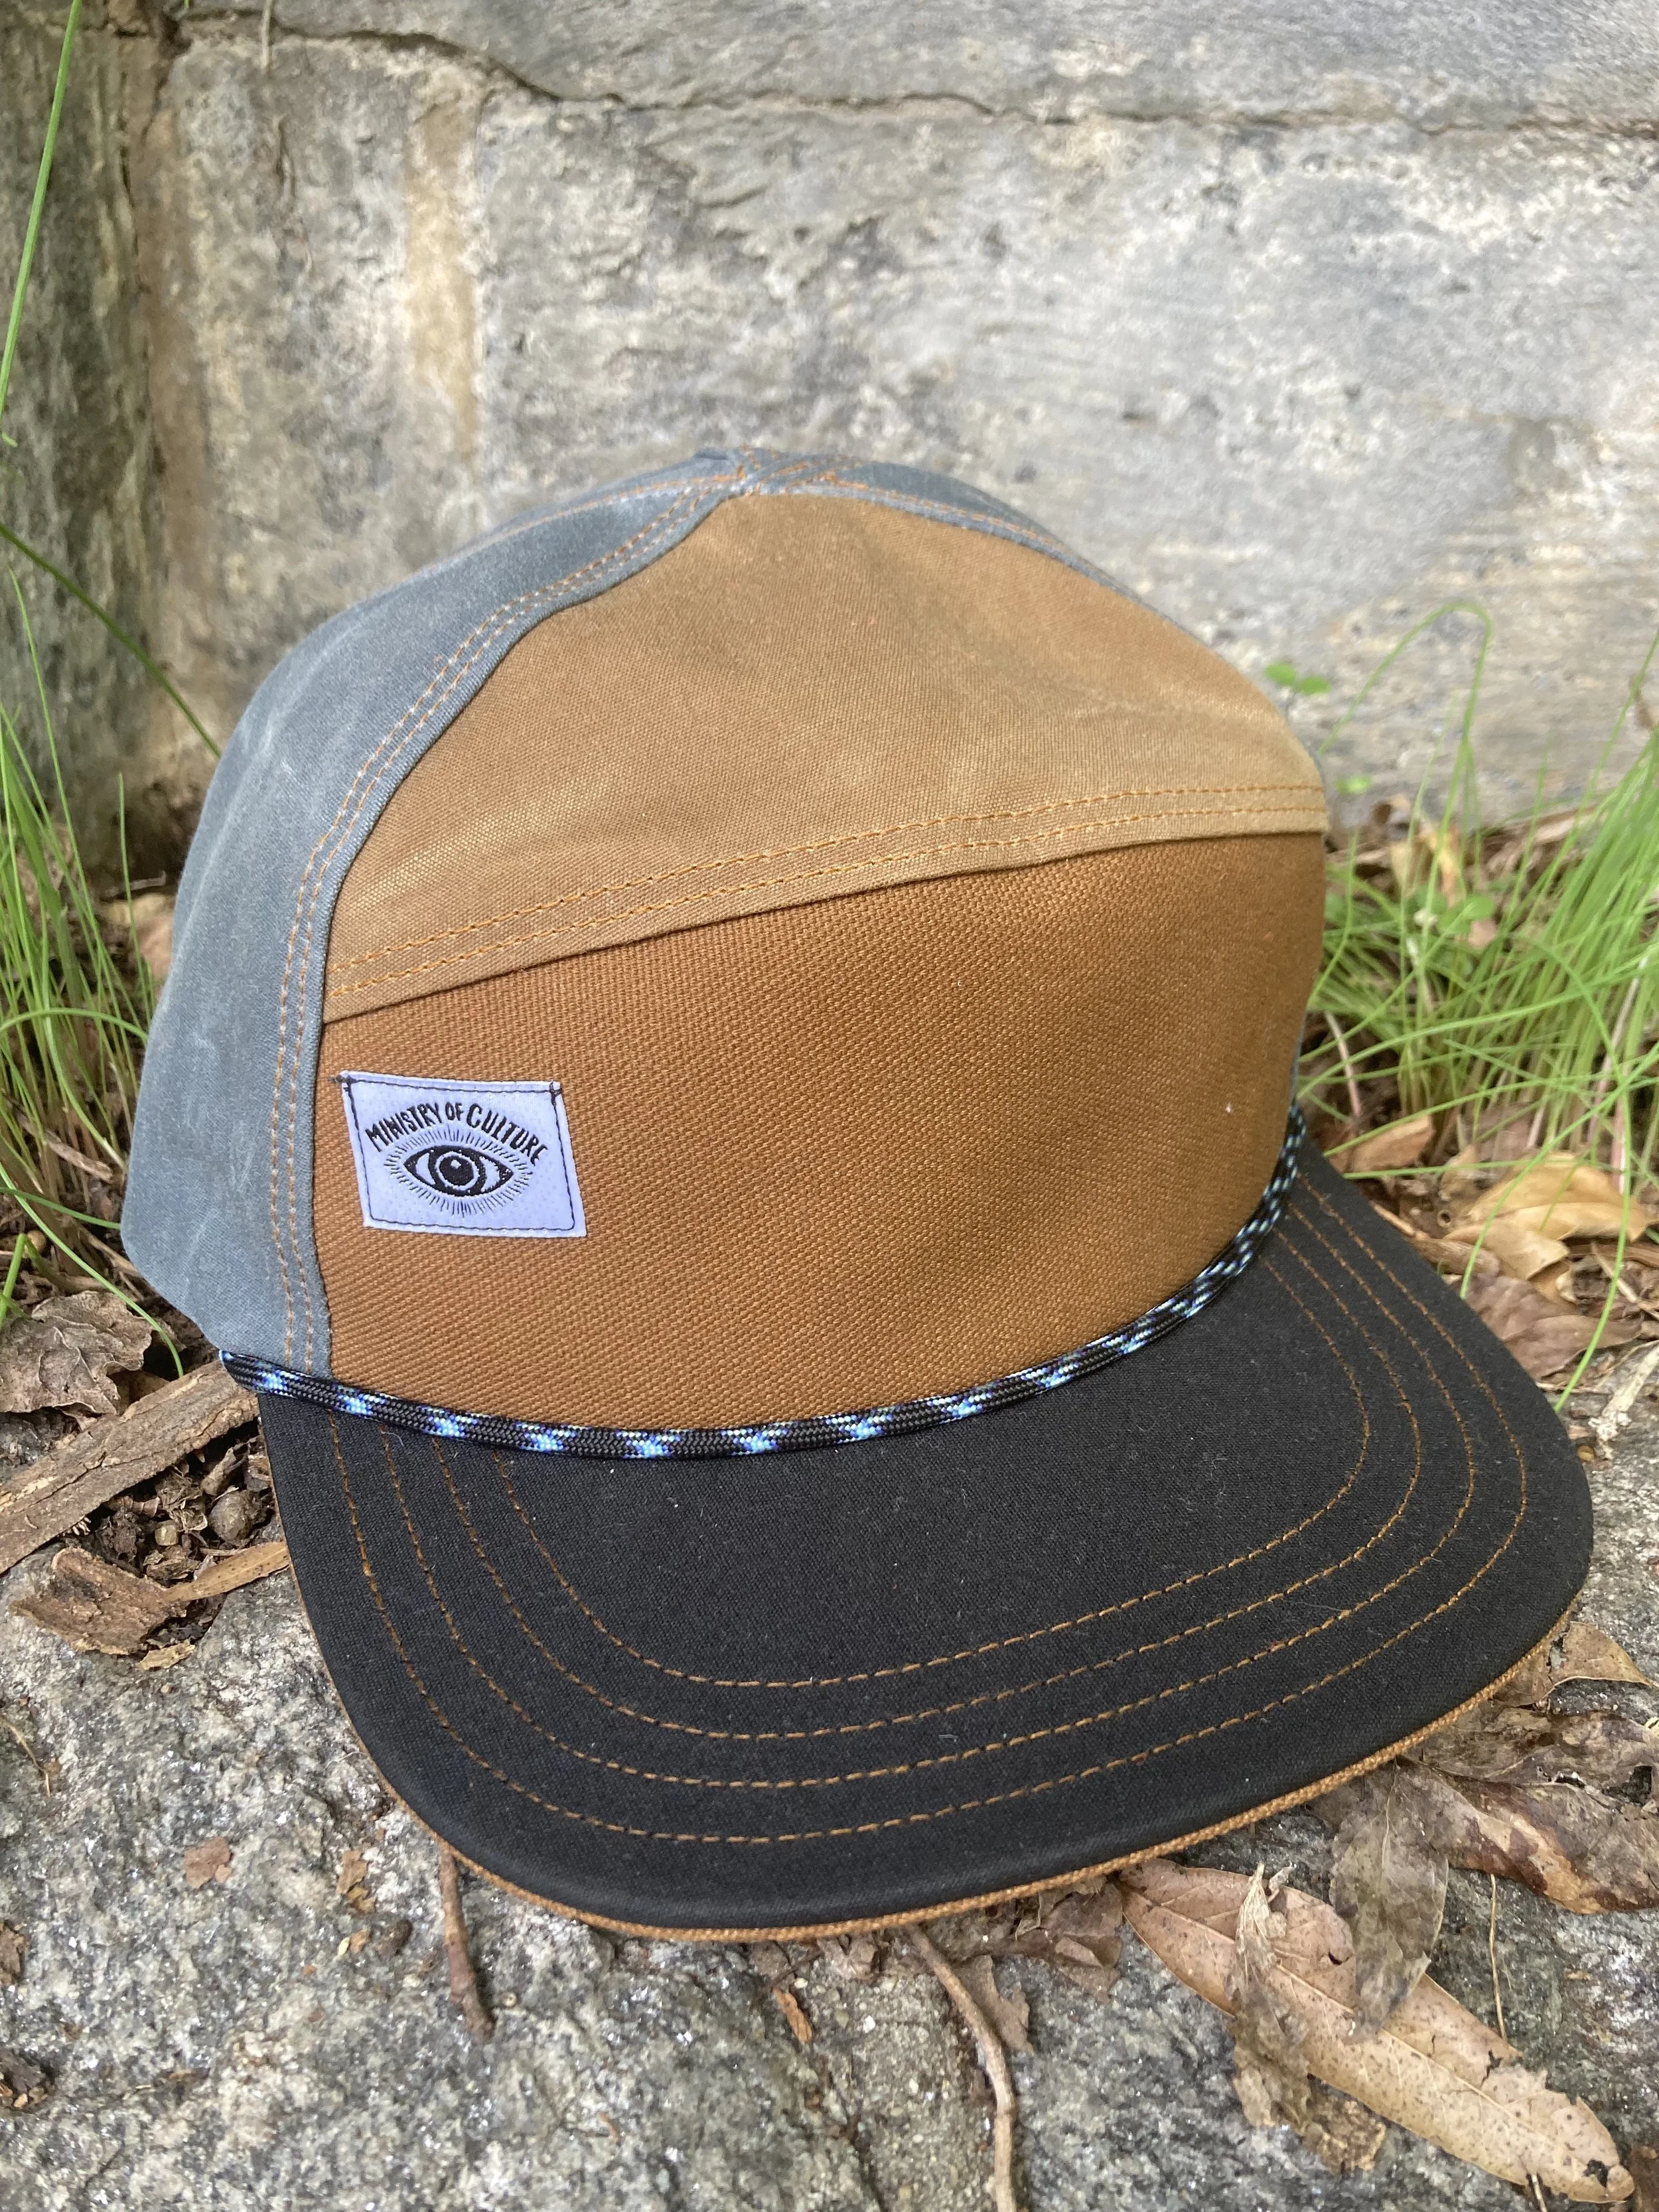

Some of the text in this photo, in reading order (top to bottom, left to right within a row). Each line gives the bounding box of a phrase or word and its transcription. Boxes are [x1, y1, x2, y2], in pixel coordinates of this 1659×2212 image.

[365, 1102, 548, 1166] MINISTRY OF CULTURE
